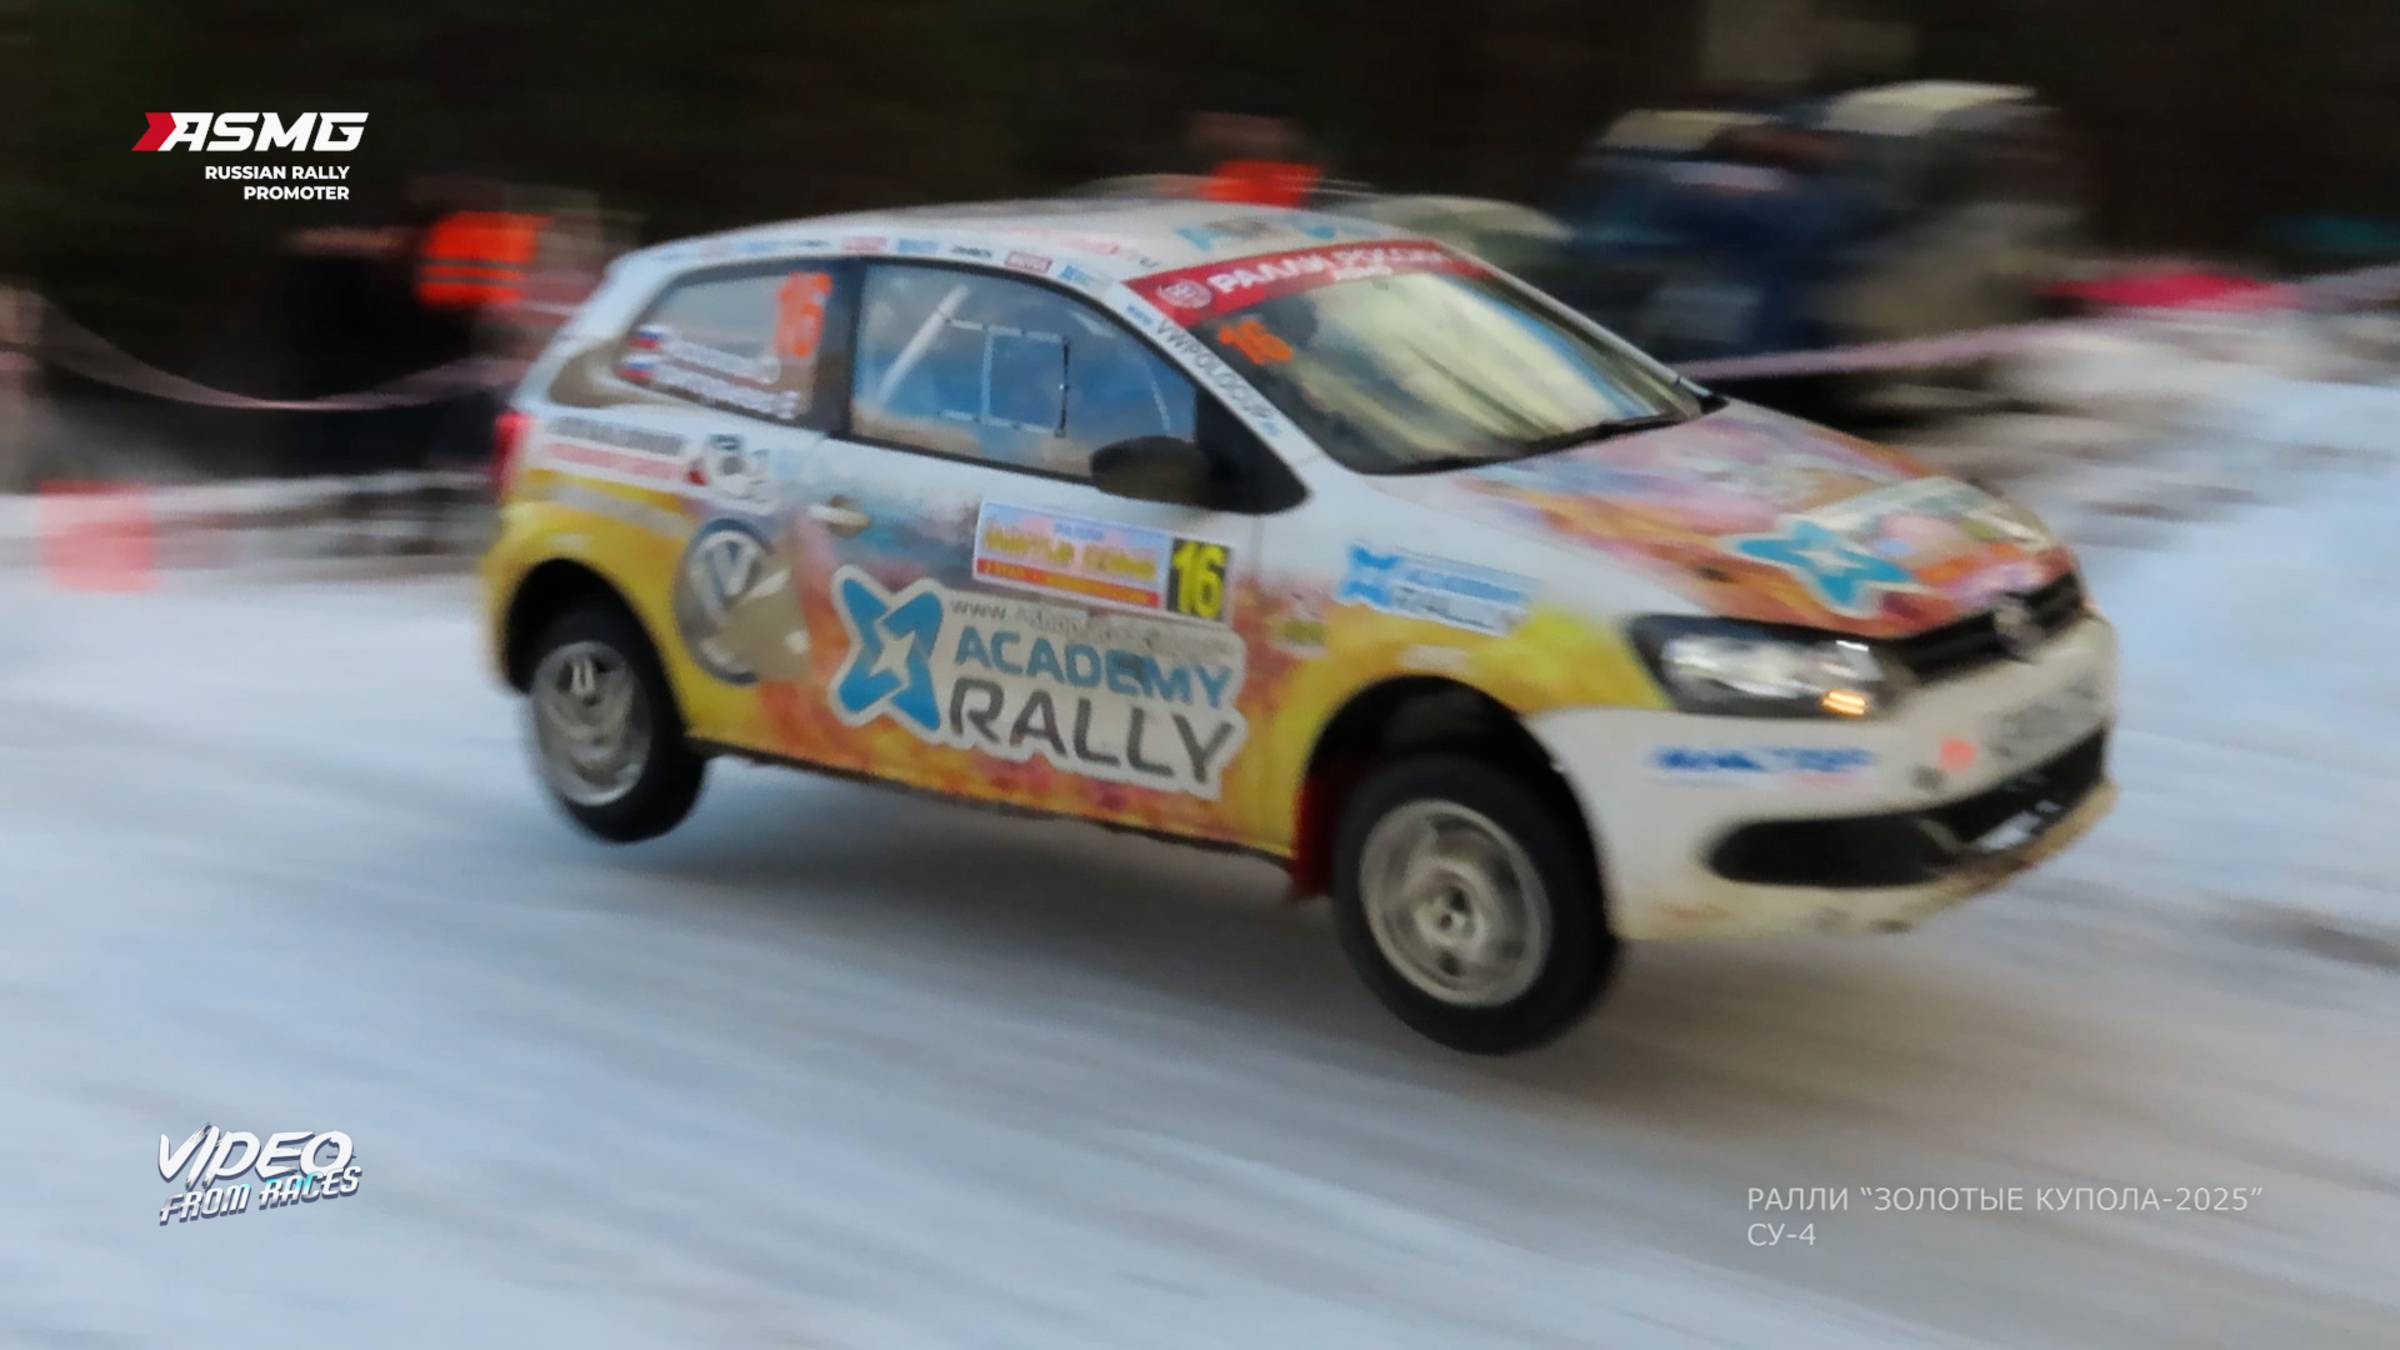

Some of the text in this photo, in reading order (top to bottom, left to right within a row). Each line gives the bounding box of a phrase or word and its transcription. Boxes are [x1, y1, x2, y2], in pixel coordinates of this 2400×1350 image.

[776, 272, 833, 358] 16
[1217, 320, 1293, 366] 16
[1172, 539, 1229, 618] 16
[954, 625, 1234, 709] ACADEMY
[949, 676, 1235, 785] RALLY
